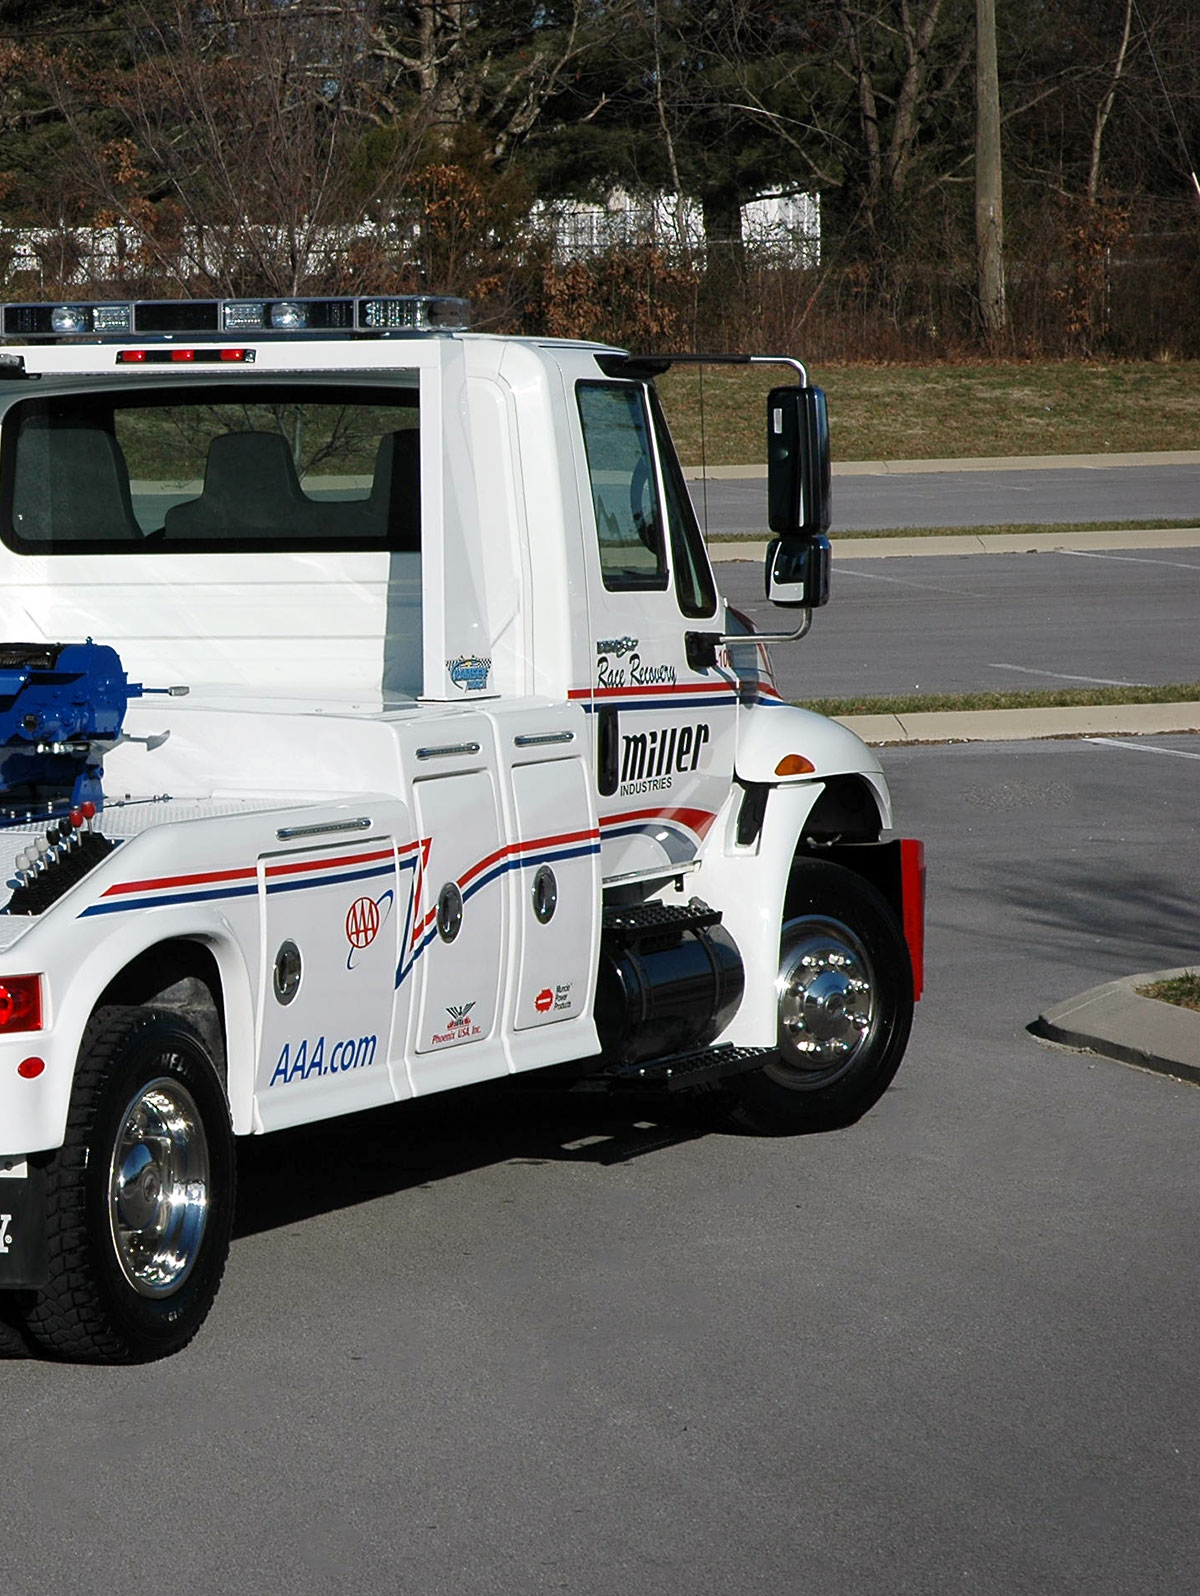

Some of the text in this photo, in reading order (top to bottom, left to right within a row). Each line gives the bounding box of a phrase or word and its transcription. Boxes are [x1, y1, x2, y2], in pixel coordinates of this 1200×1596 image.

[597, 653, 677, 690] Race Recovery
[621, 723, 710, 783] miller
[620, 777, 673, 797] INDUSTRIES
[346, 896, 380, 949] AAA
[269, 1034, 377, 1087] AAA.com
